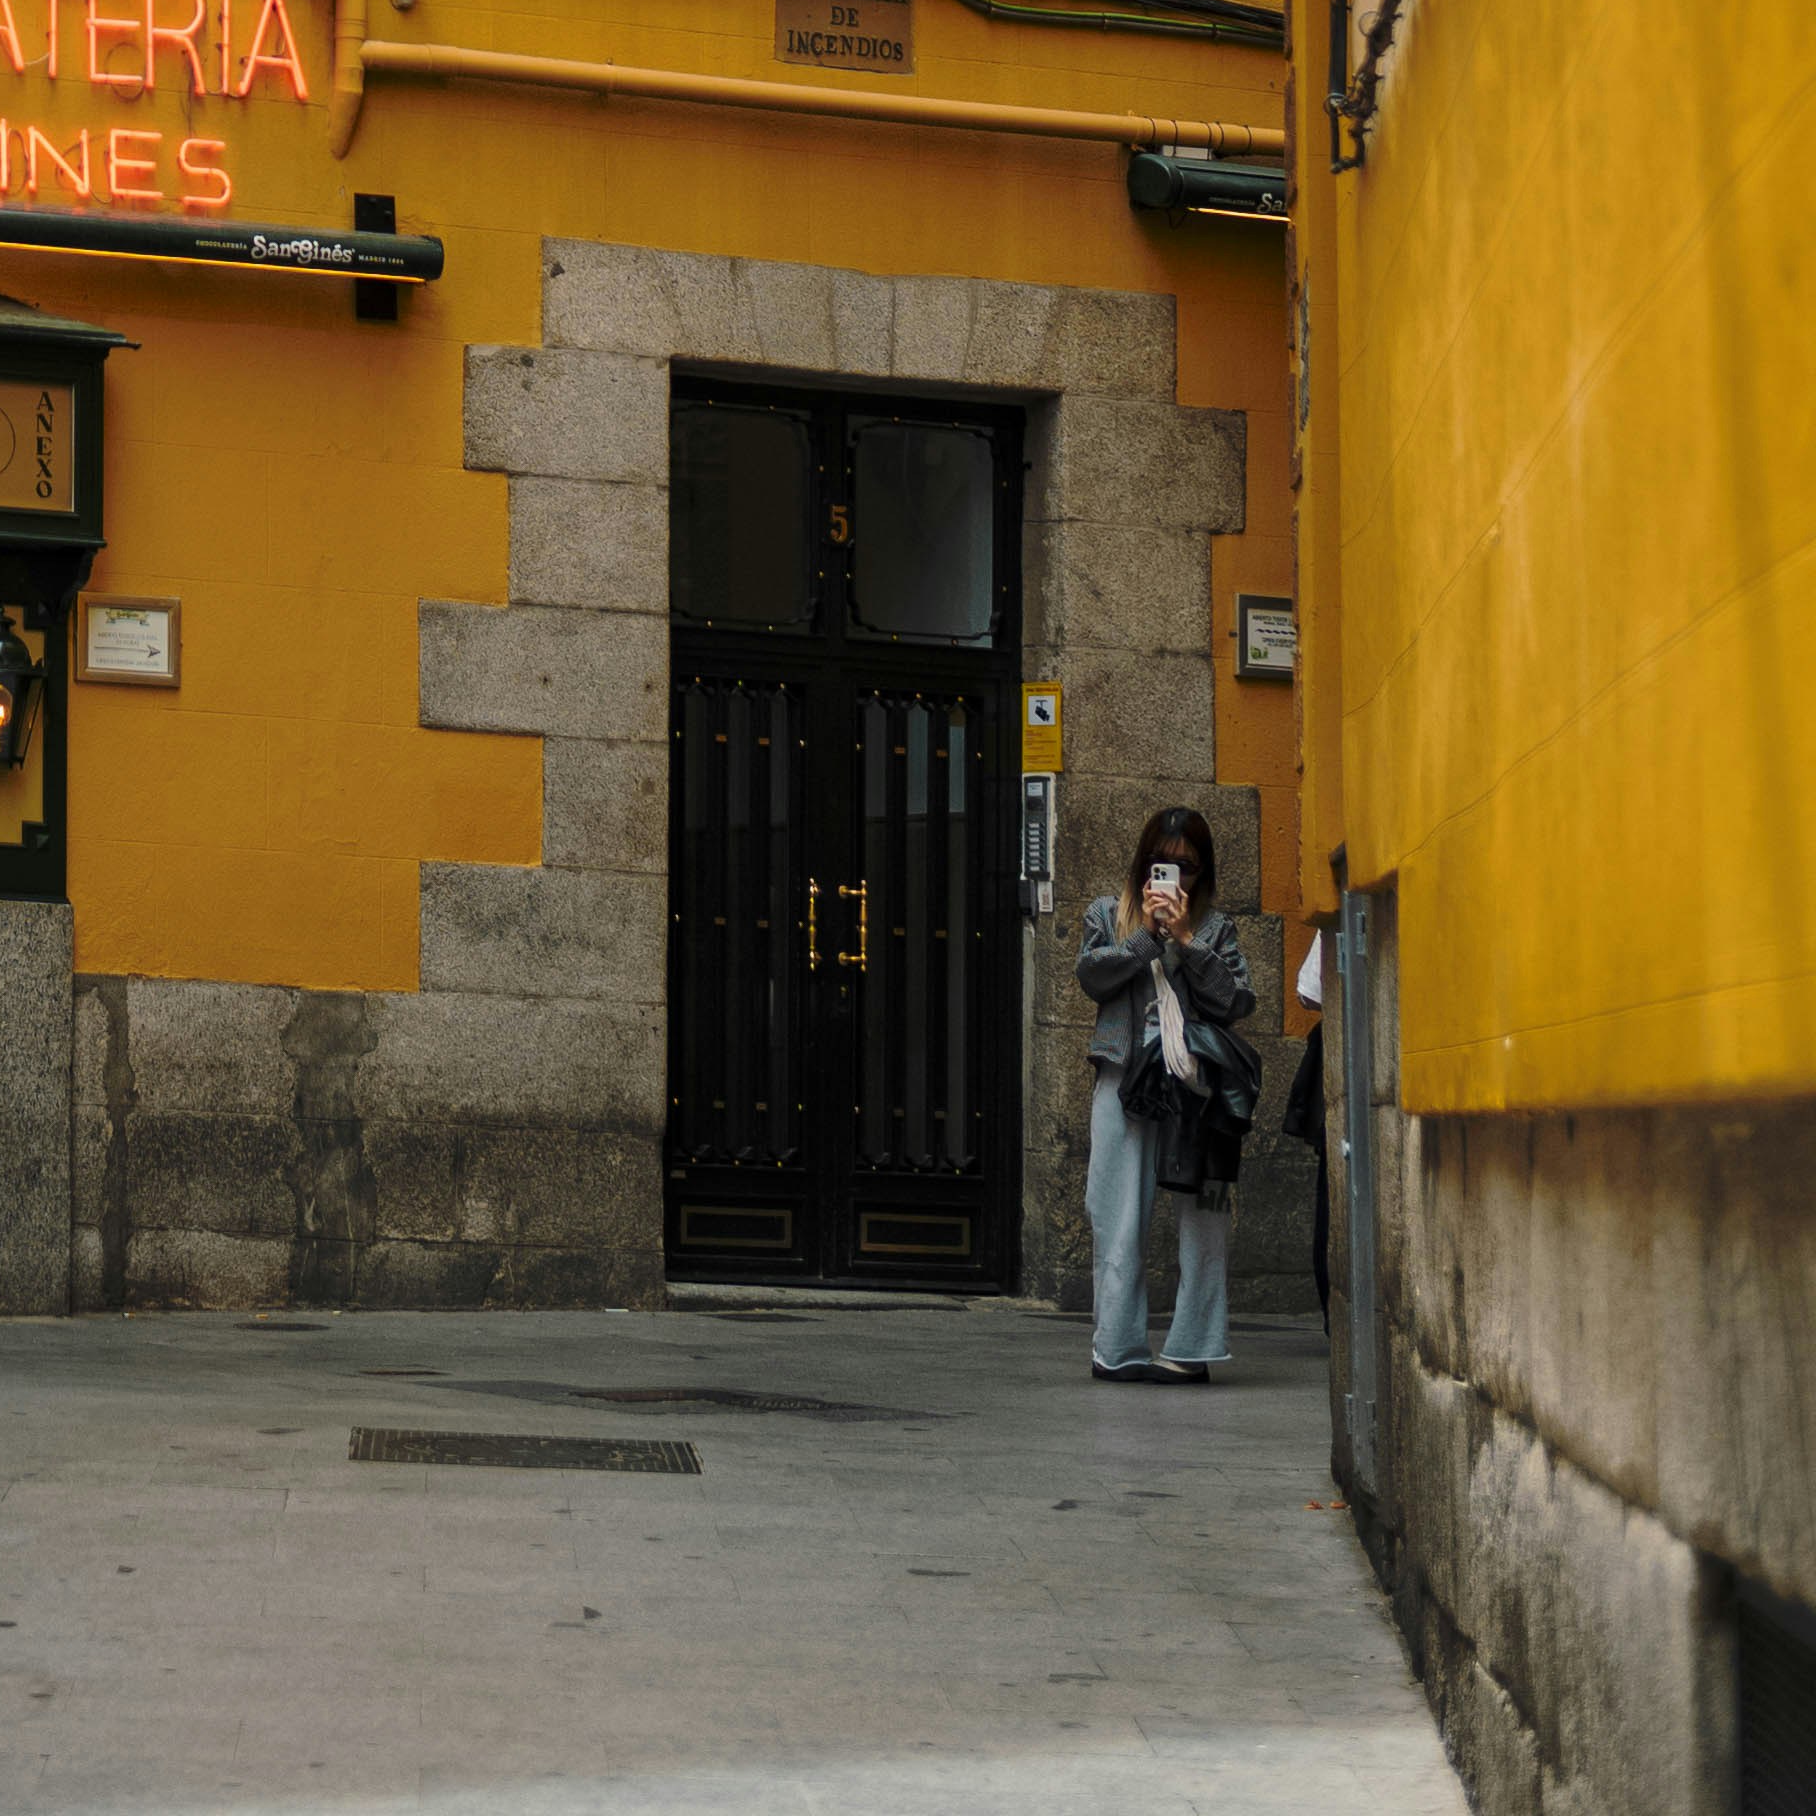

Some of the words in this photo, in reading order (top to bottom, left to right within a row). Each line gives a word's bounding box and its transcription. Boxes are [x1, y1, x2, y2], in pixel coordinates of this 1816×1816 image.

[830, 6, 859, 27] DE
[786, 29, 904, 62] INCENDIOS
[35, 390, 55, 499] ANEXO
[830, 503, 848, 544] 5
